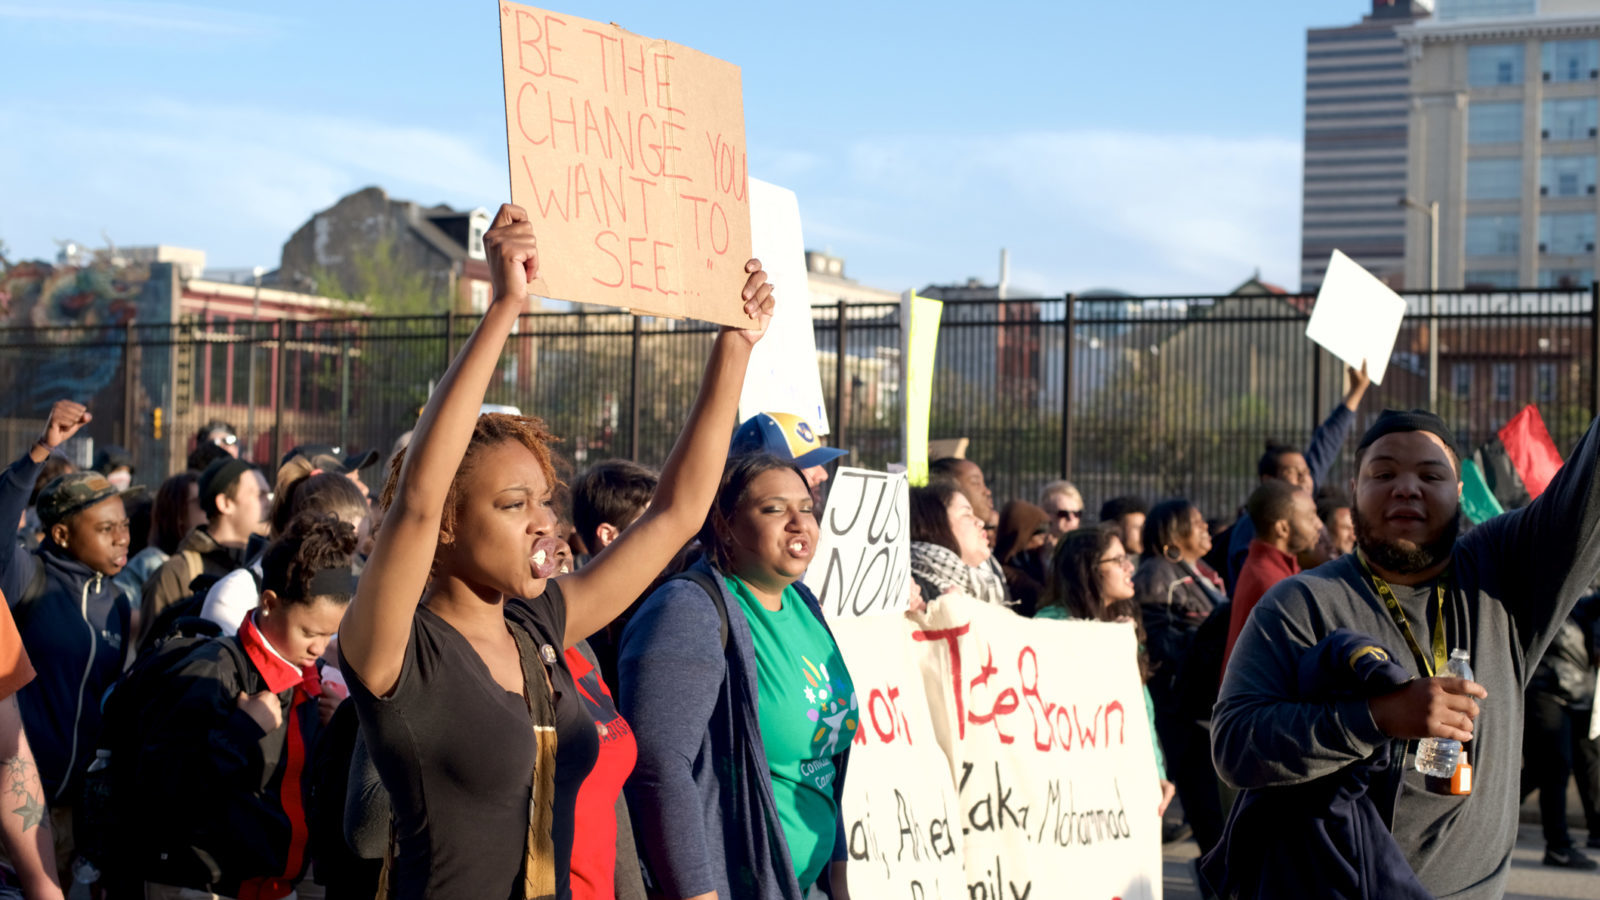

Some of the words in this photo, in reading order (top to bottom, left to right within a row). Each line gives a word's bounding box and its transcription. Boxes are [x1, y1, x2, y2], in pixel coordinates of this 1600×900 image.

[583, 29, 686, 116] THE
[517, 82, 693, 182] CHANGE
[706, 131, 747, 203] YOU
[522, 155, 657, 235] WANT
[679, 194, 729, 255] TO
[829, 471, 908, 545] JUS
